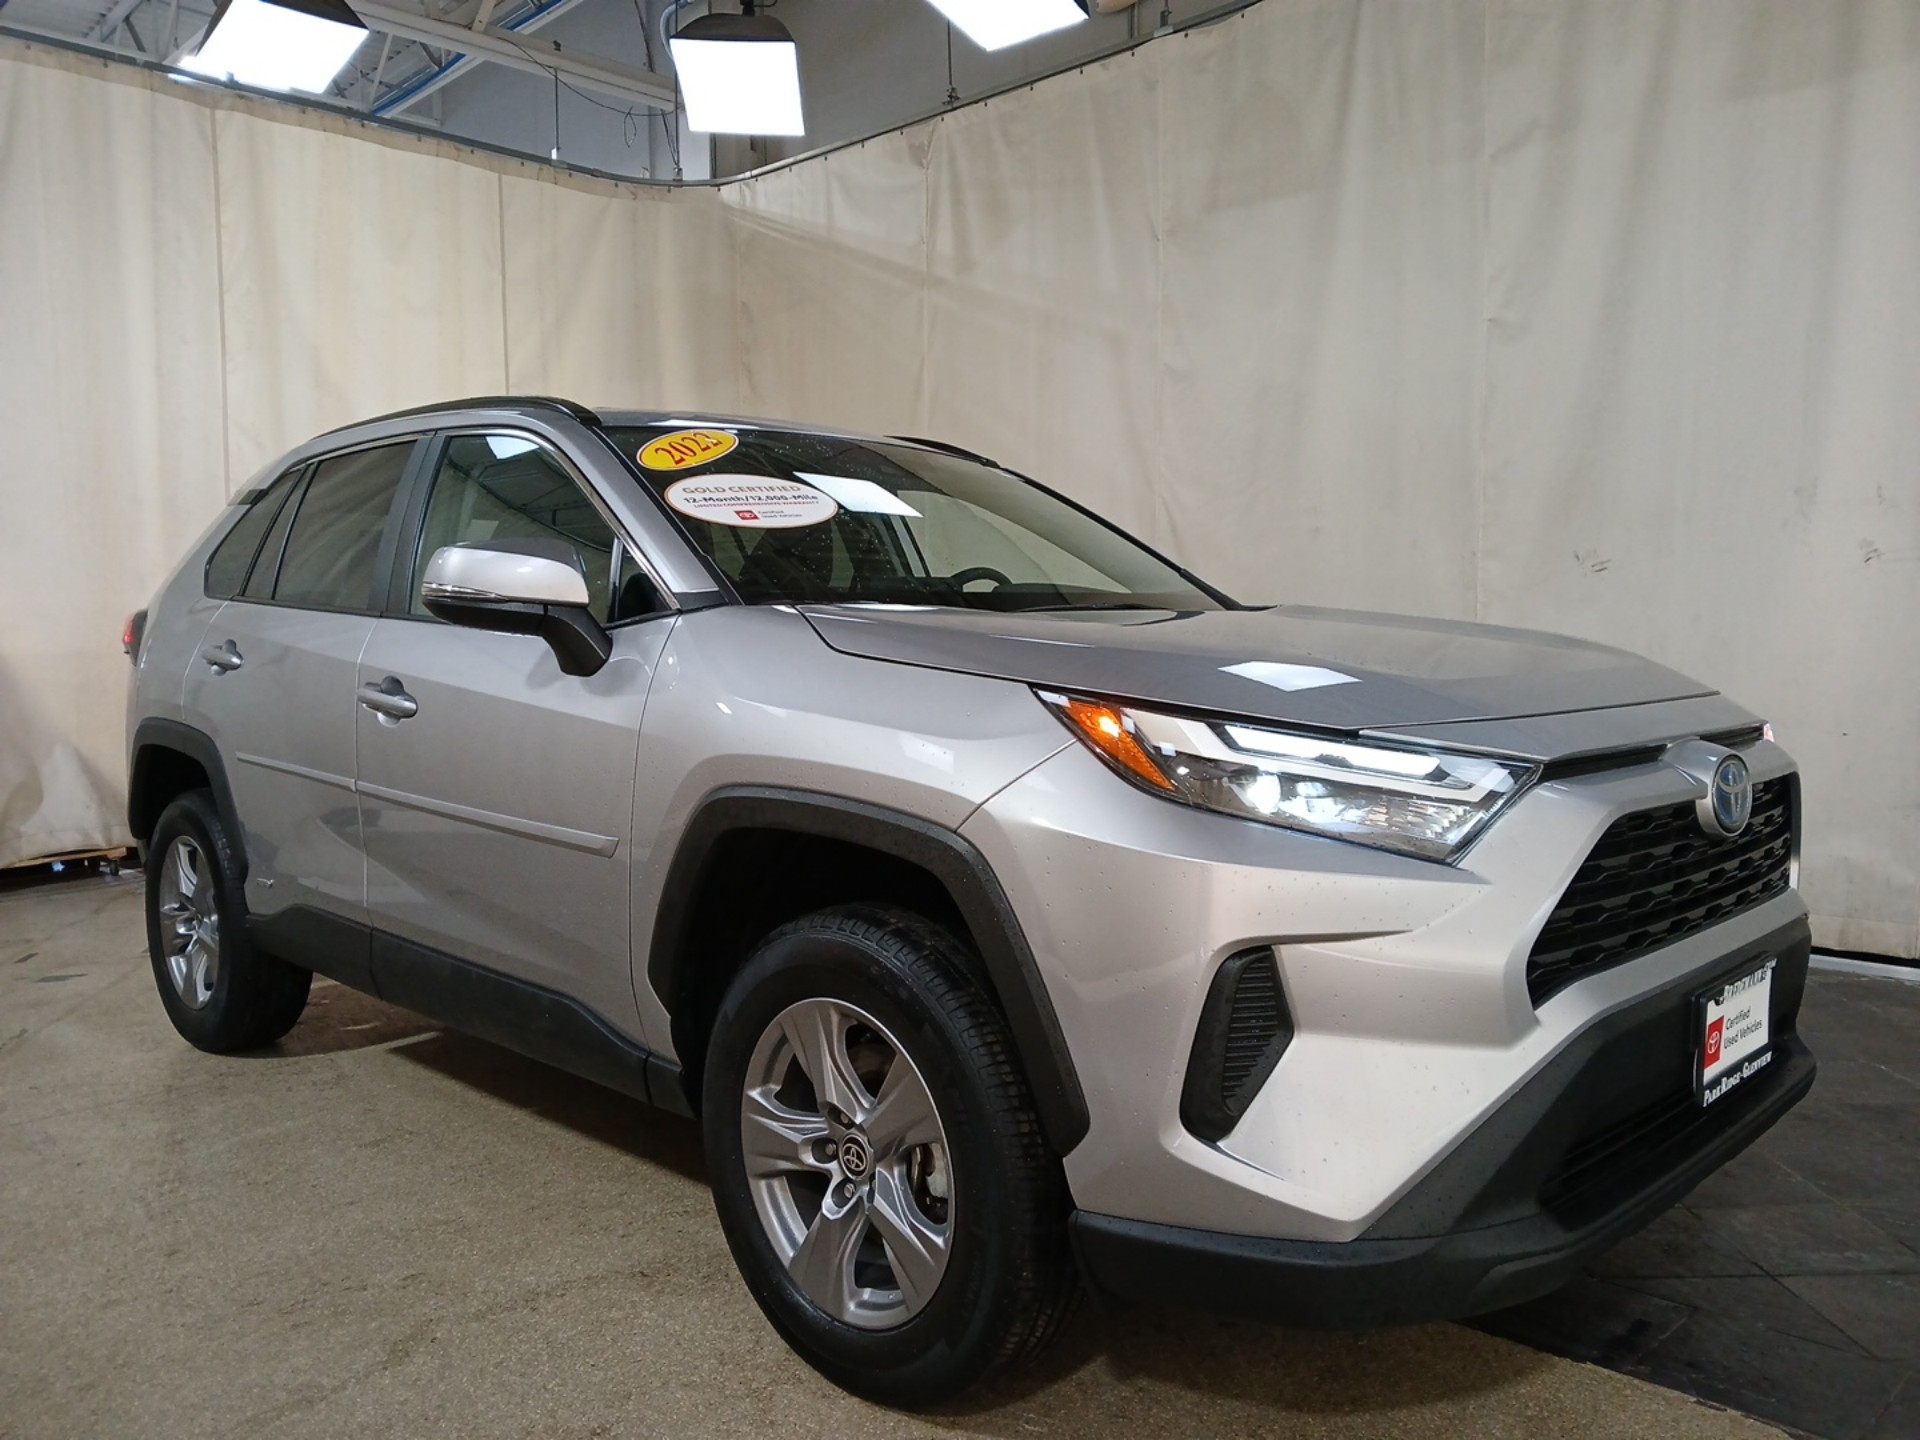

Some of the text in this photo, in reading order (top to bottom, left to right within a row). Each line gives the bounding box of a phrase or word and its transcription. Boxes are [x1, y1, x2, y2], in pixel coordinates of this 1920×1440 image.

[682, 485, 802, 494] GOLD CERTIFIED
[1725, 1006, 1751, 1031] Certified
[1723, 1019, 1763, 1050] Used Vehicles
